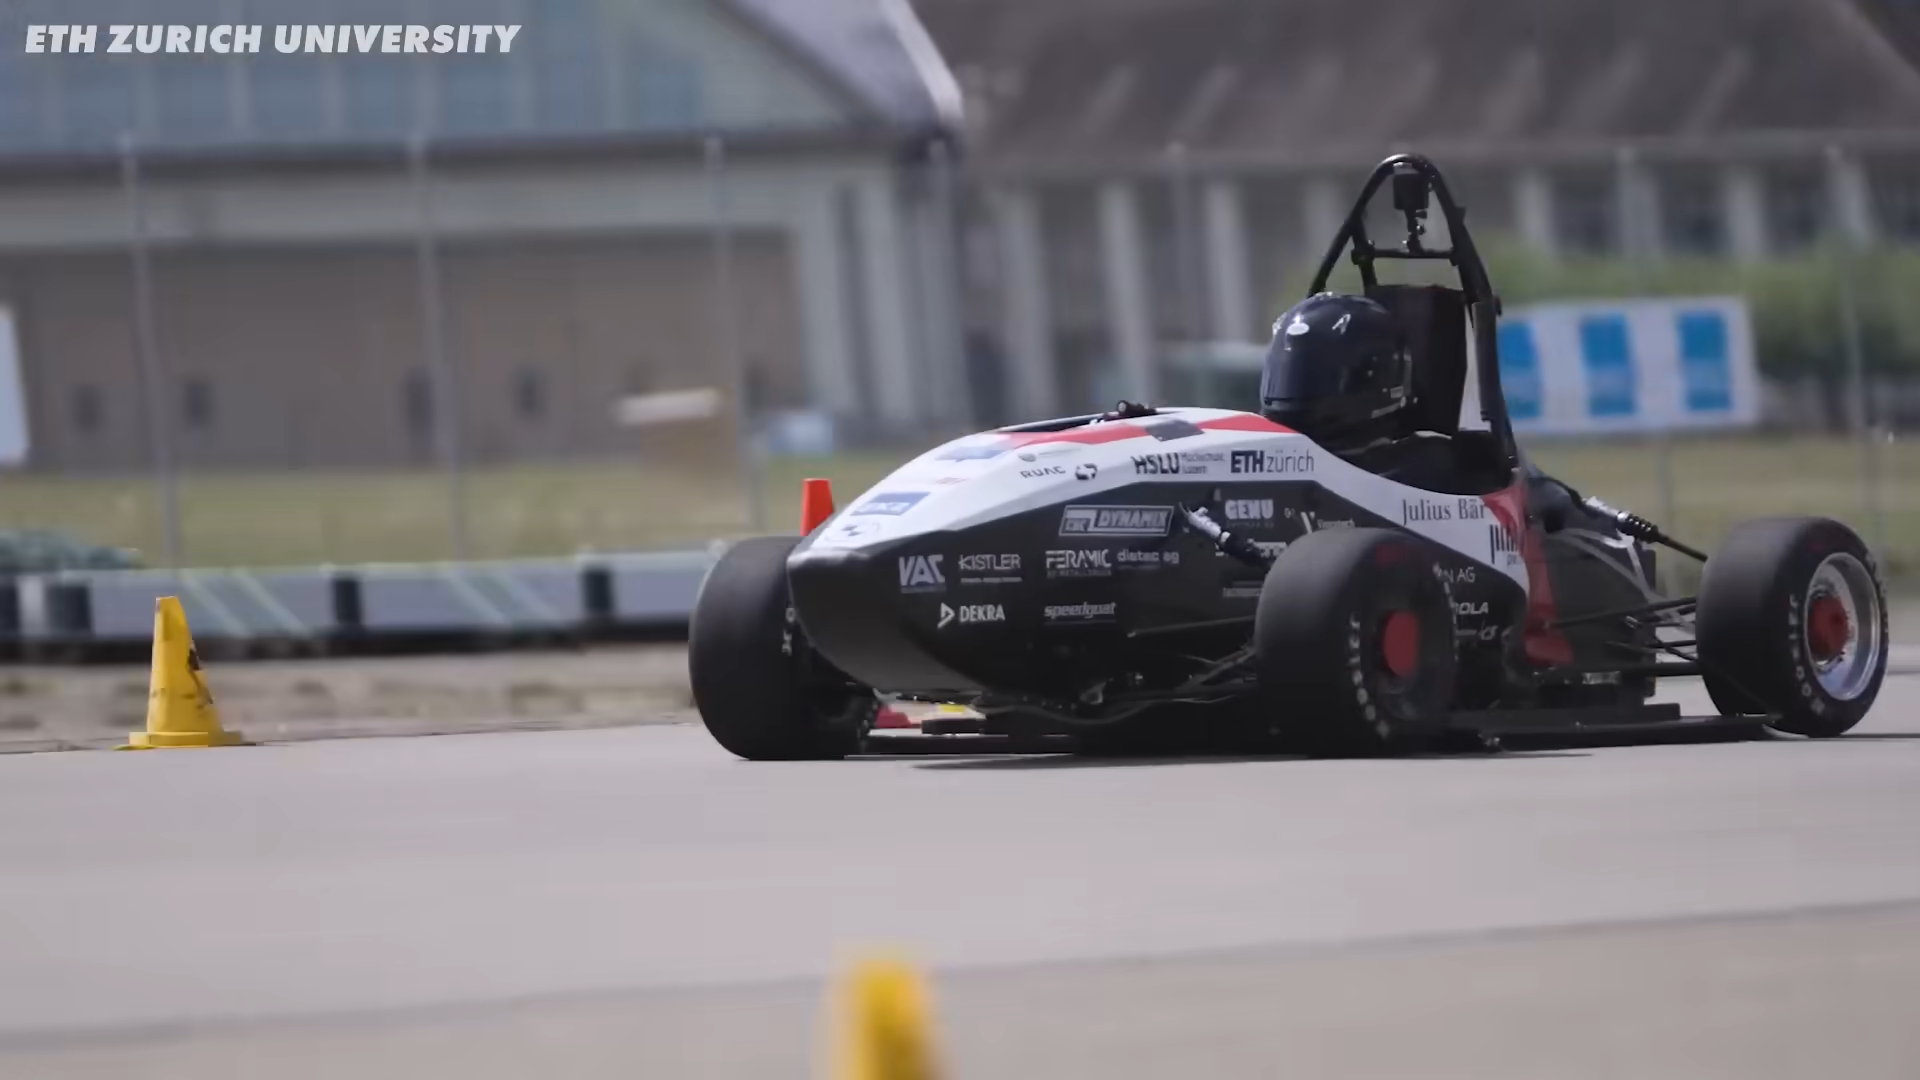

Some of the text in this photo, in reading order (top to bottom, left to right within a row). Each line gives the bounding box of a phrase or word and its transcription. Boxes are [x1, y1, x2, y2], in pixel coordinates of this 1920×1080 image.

[1131, 452, 1180, 474] HSLU
[1097, 509, 1169, 528] DYNAMIX
[1403, 498, 1485, 527] Julius Bär
[958, 554, 1021, 570] KISTLER
[1045, 549, 1112, 568] FERAMIC
[899, 554, 945, 586] VAC
[1457, 566, 1476, 583] AG
[960, 604, 1005, 622] DEKRA
